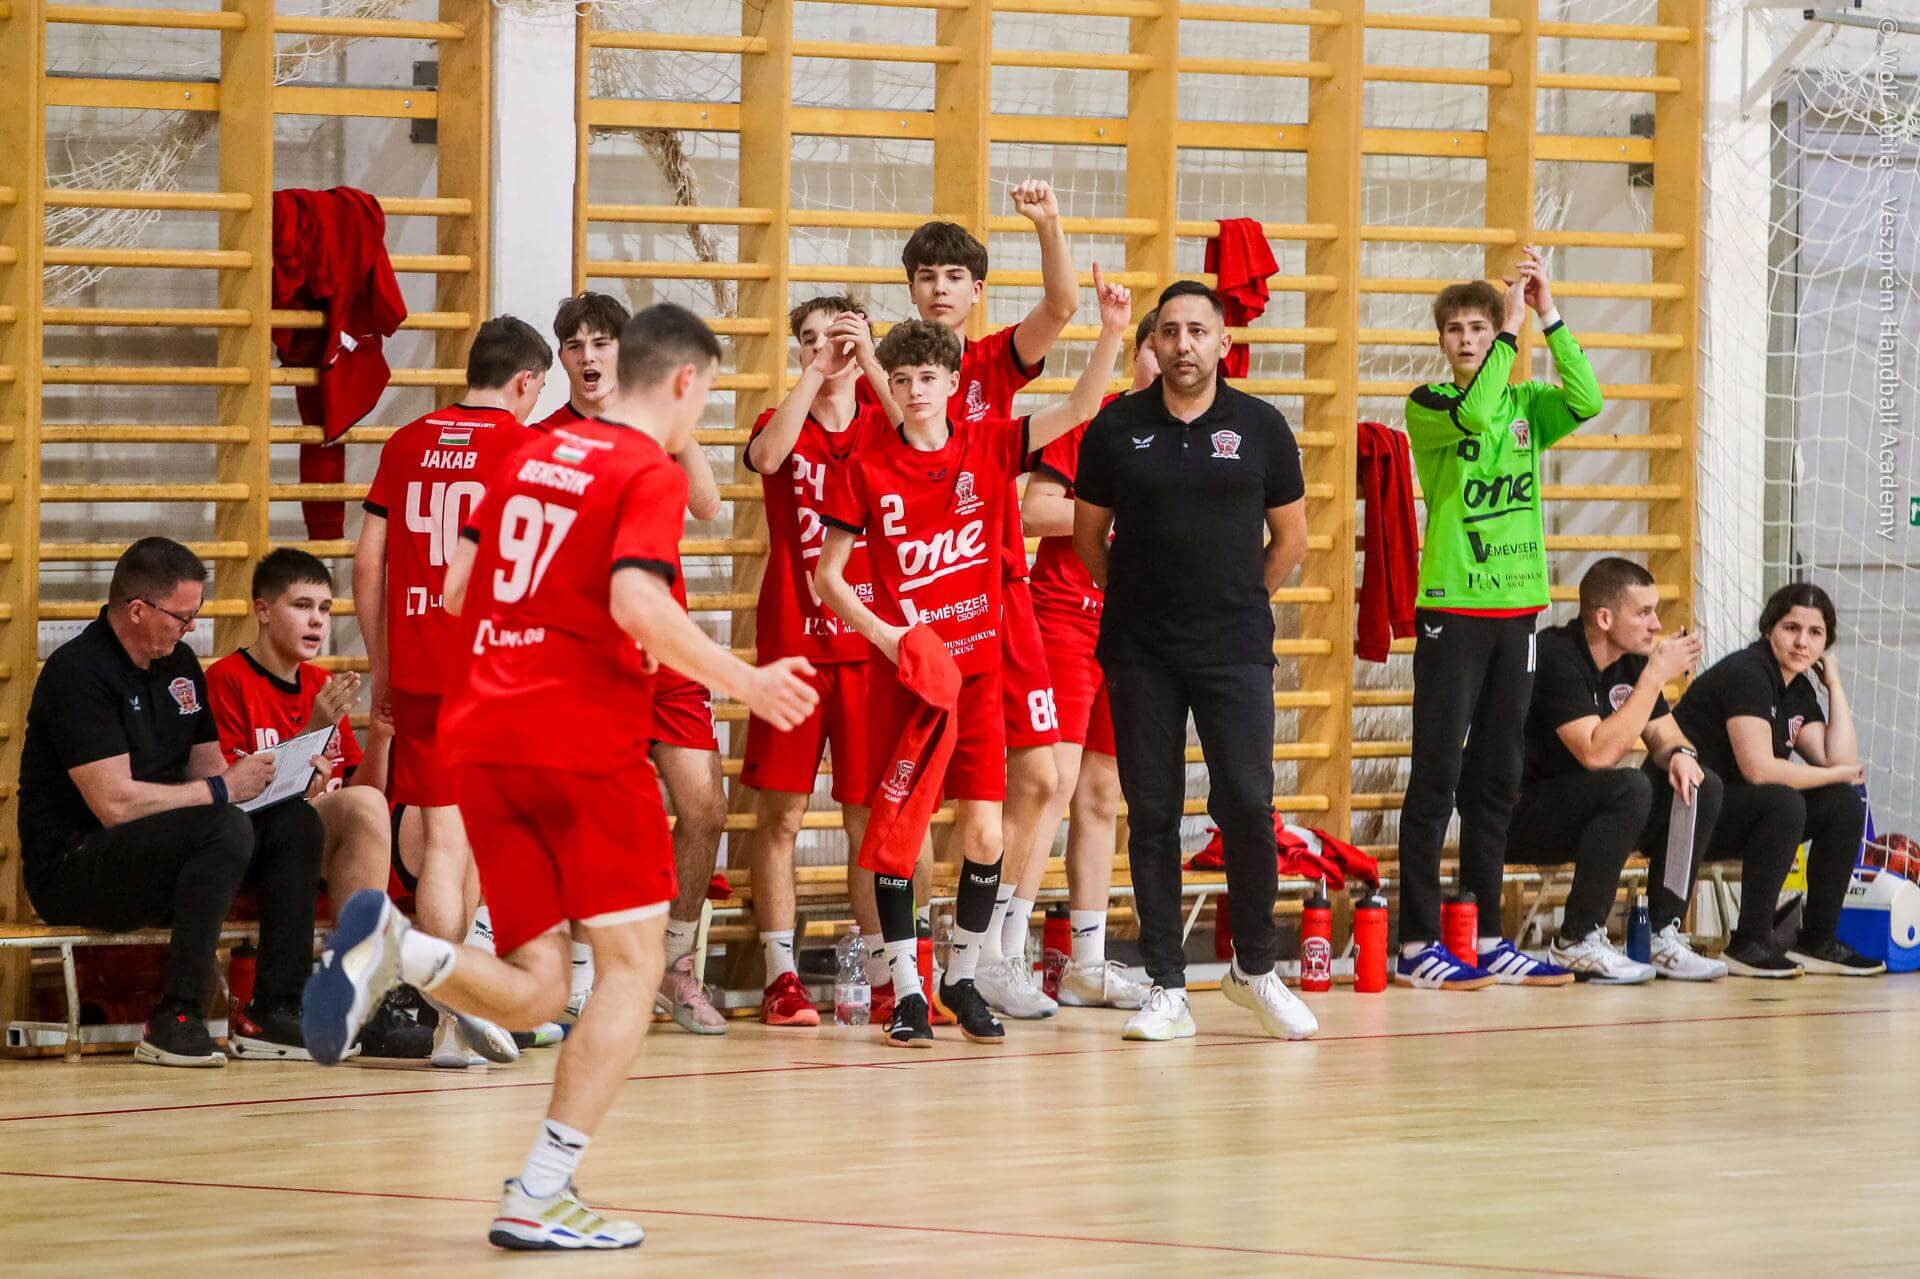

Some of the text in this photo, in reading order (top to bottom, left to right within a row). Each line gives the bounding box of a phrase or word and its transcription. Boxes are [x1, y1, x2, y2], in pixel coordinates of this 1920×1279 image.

[420, 449, 478, 470] JAKAB
[1463, 471, 1534, 509] one
[405, 480, 488, 567] 40
[879, 492, 907, 537] 2
[493, 495, 577, 604] 97
[896, 519, 987, 576] one
[879, 877, 908, 887] SELECT
[970, 873, 999, 884] SELECT
